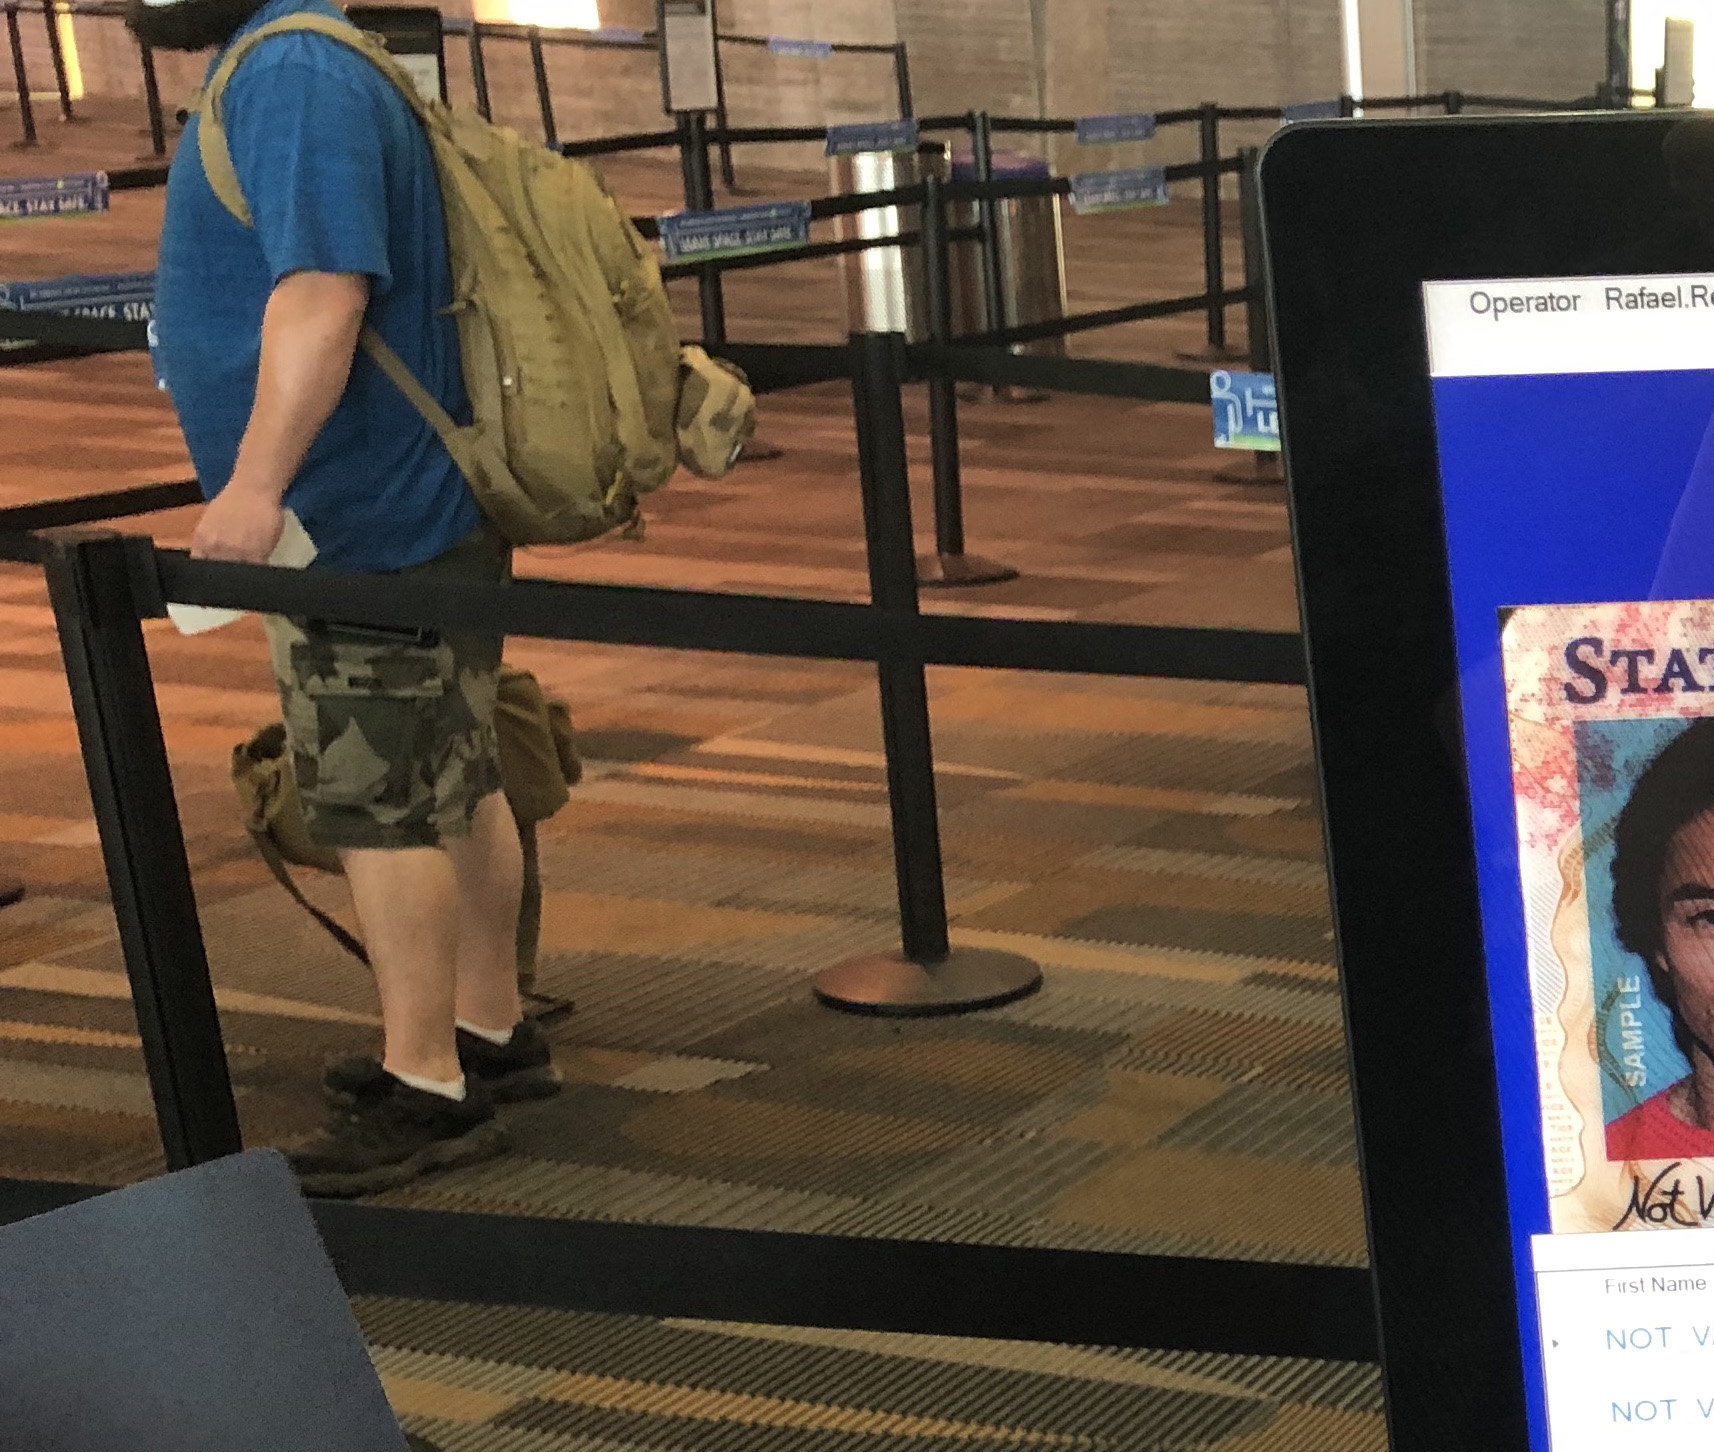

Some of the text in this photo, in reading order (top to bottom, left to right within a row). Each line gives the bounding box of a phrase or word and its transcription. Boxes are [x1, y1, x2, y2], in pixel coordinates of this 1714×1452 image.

[1469, 289, 1581, 321] Operator
[1617, 974, 1648, 1088] SAMPLE
[1611, 1161, 1699, 1232] Not
[1604, 1275, 1708, 1295] First Name
[1605, 1325, 1673, 1351] NOT
[1611, 1398, 1679, 1423] NOT
